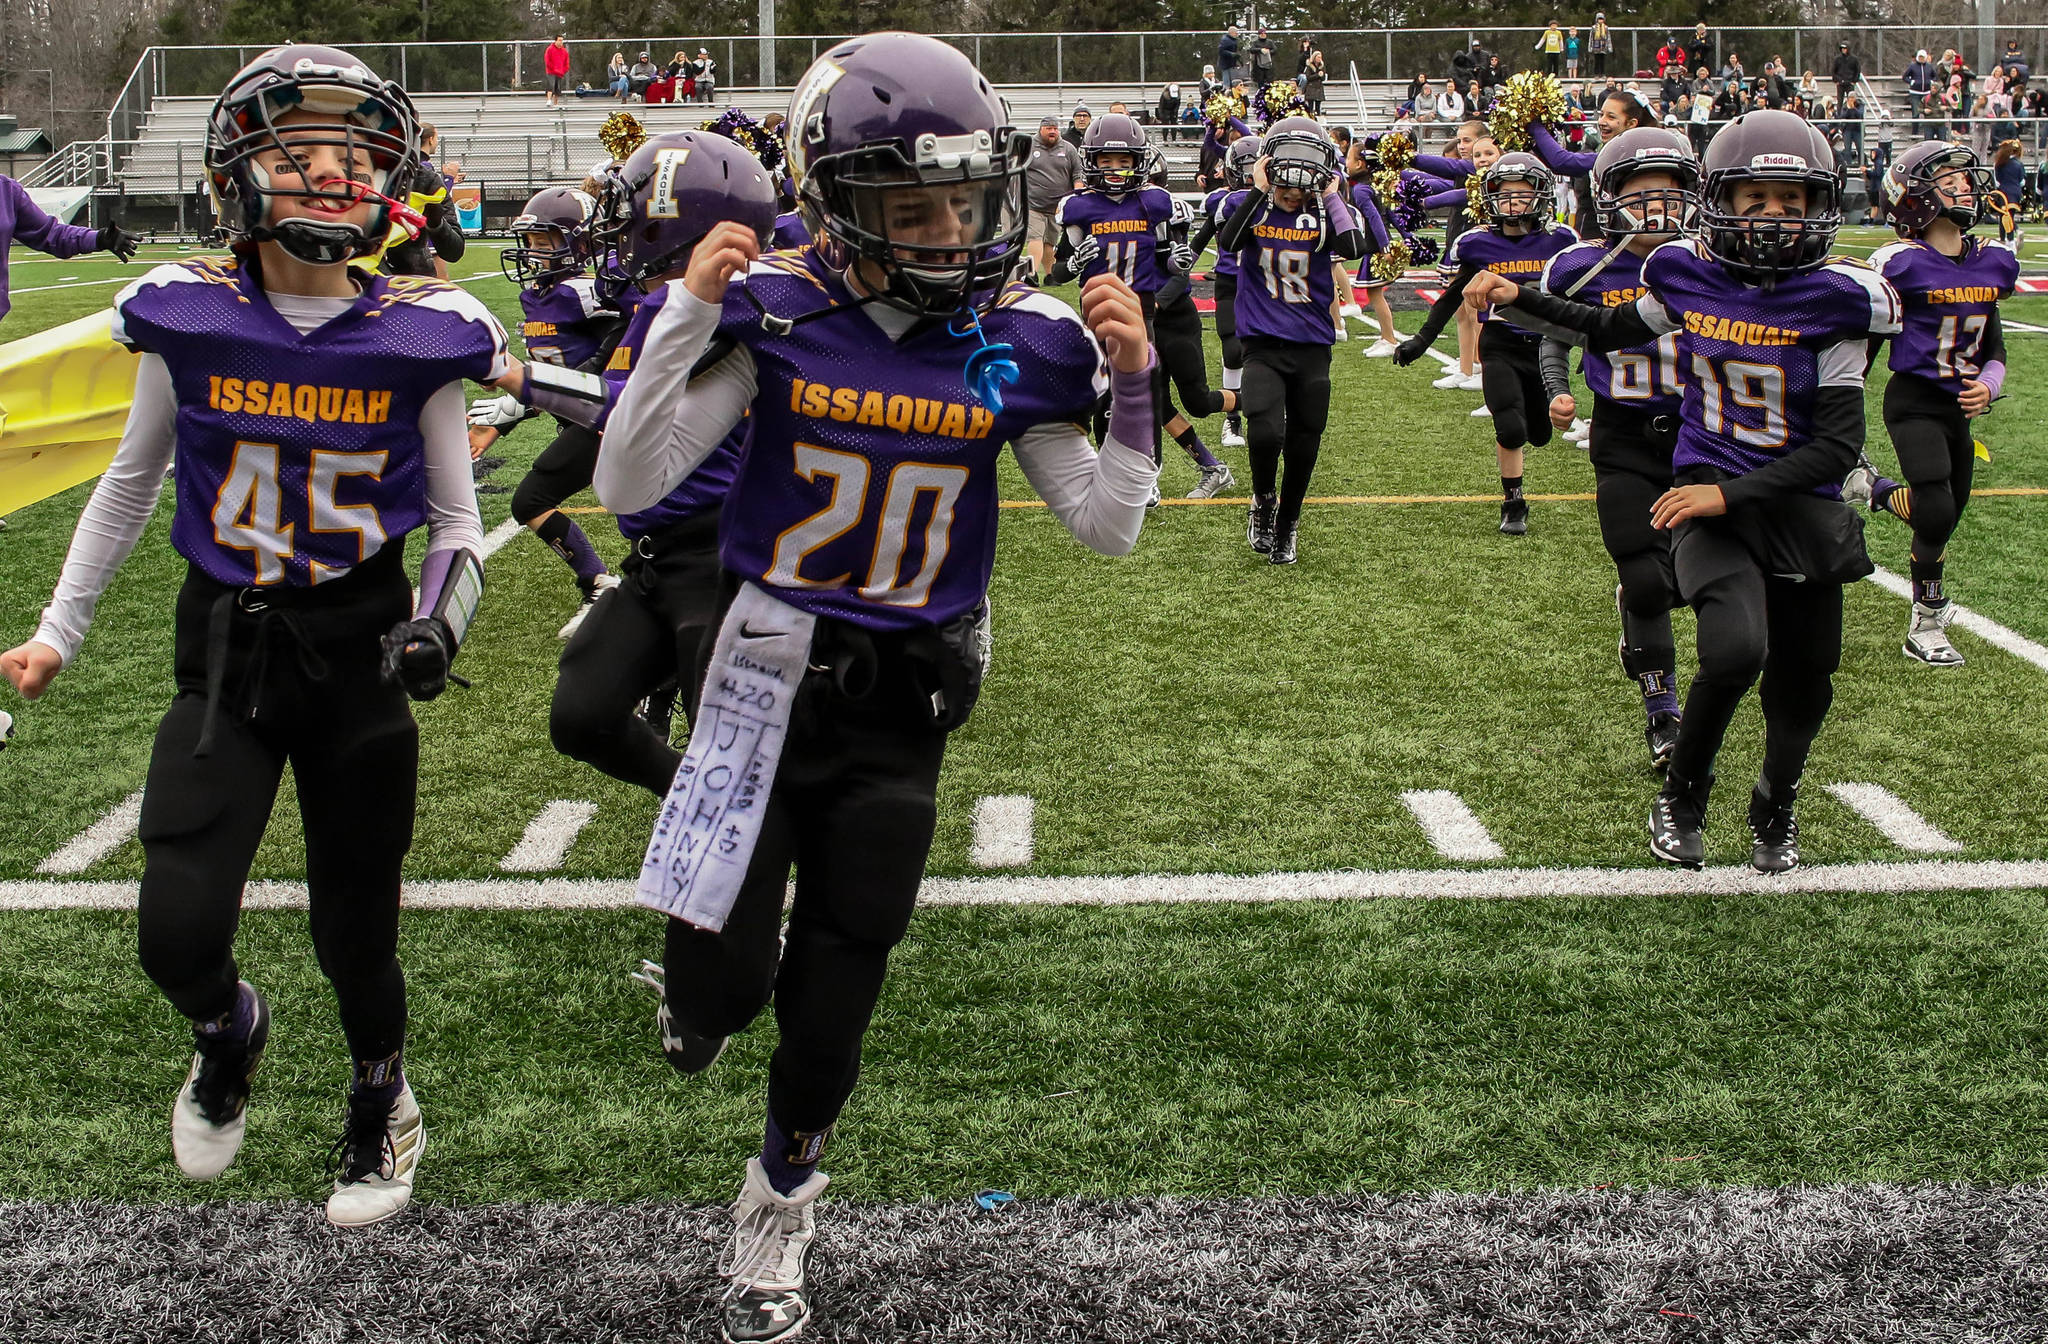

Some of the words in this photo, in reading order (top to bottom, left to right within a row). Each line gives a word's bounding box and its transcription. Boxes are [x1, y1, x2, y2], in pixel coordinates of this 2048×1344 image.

[658, 151, 675, 214] ISSAQUAH
[1763, 155, 1794, 165] Riddell
[1091, 219, 1148, 235] ISSAQUAH
[1105, 240, 1138, 287] 11
[1258, 246, 1311, 304] 18
[1683, 310, 1800, 346] ISSAQUAH
[1935, 314, 1988, 378] 12
[209, 375, 392, 424] ISSAQUAH
[790, 378, 996, 440] ISSAQUAH
[1691, 352, 1790, 448] 19
[210, 440, 390, 586] 45
[761, 441, 971, 608] 20
